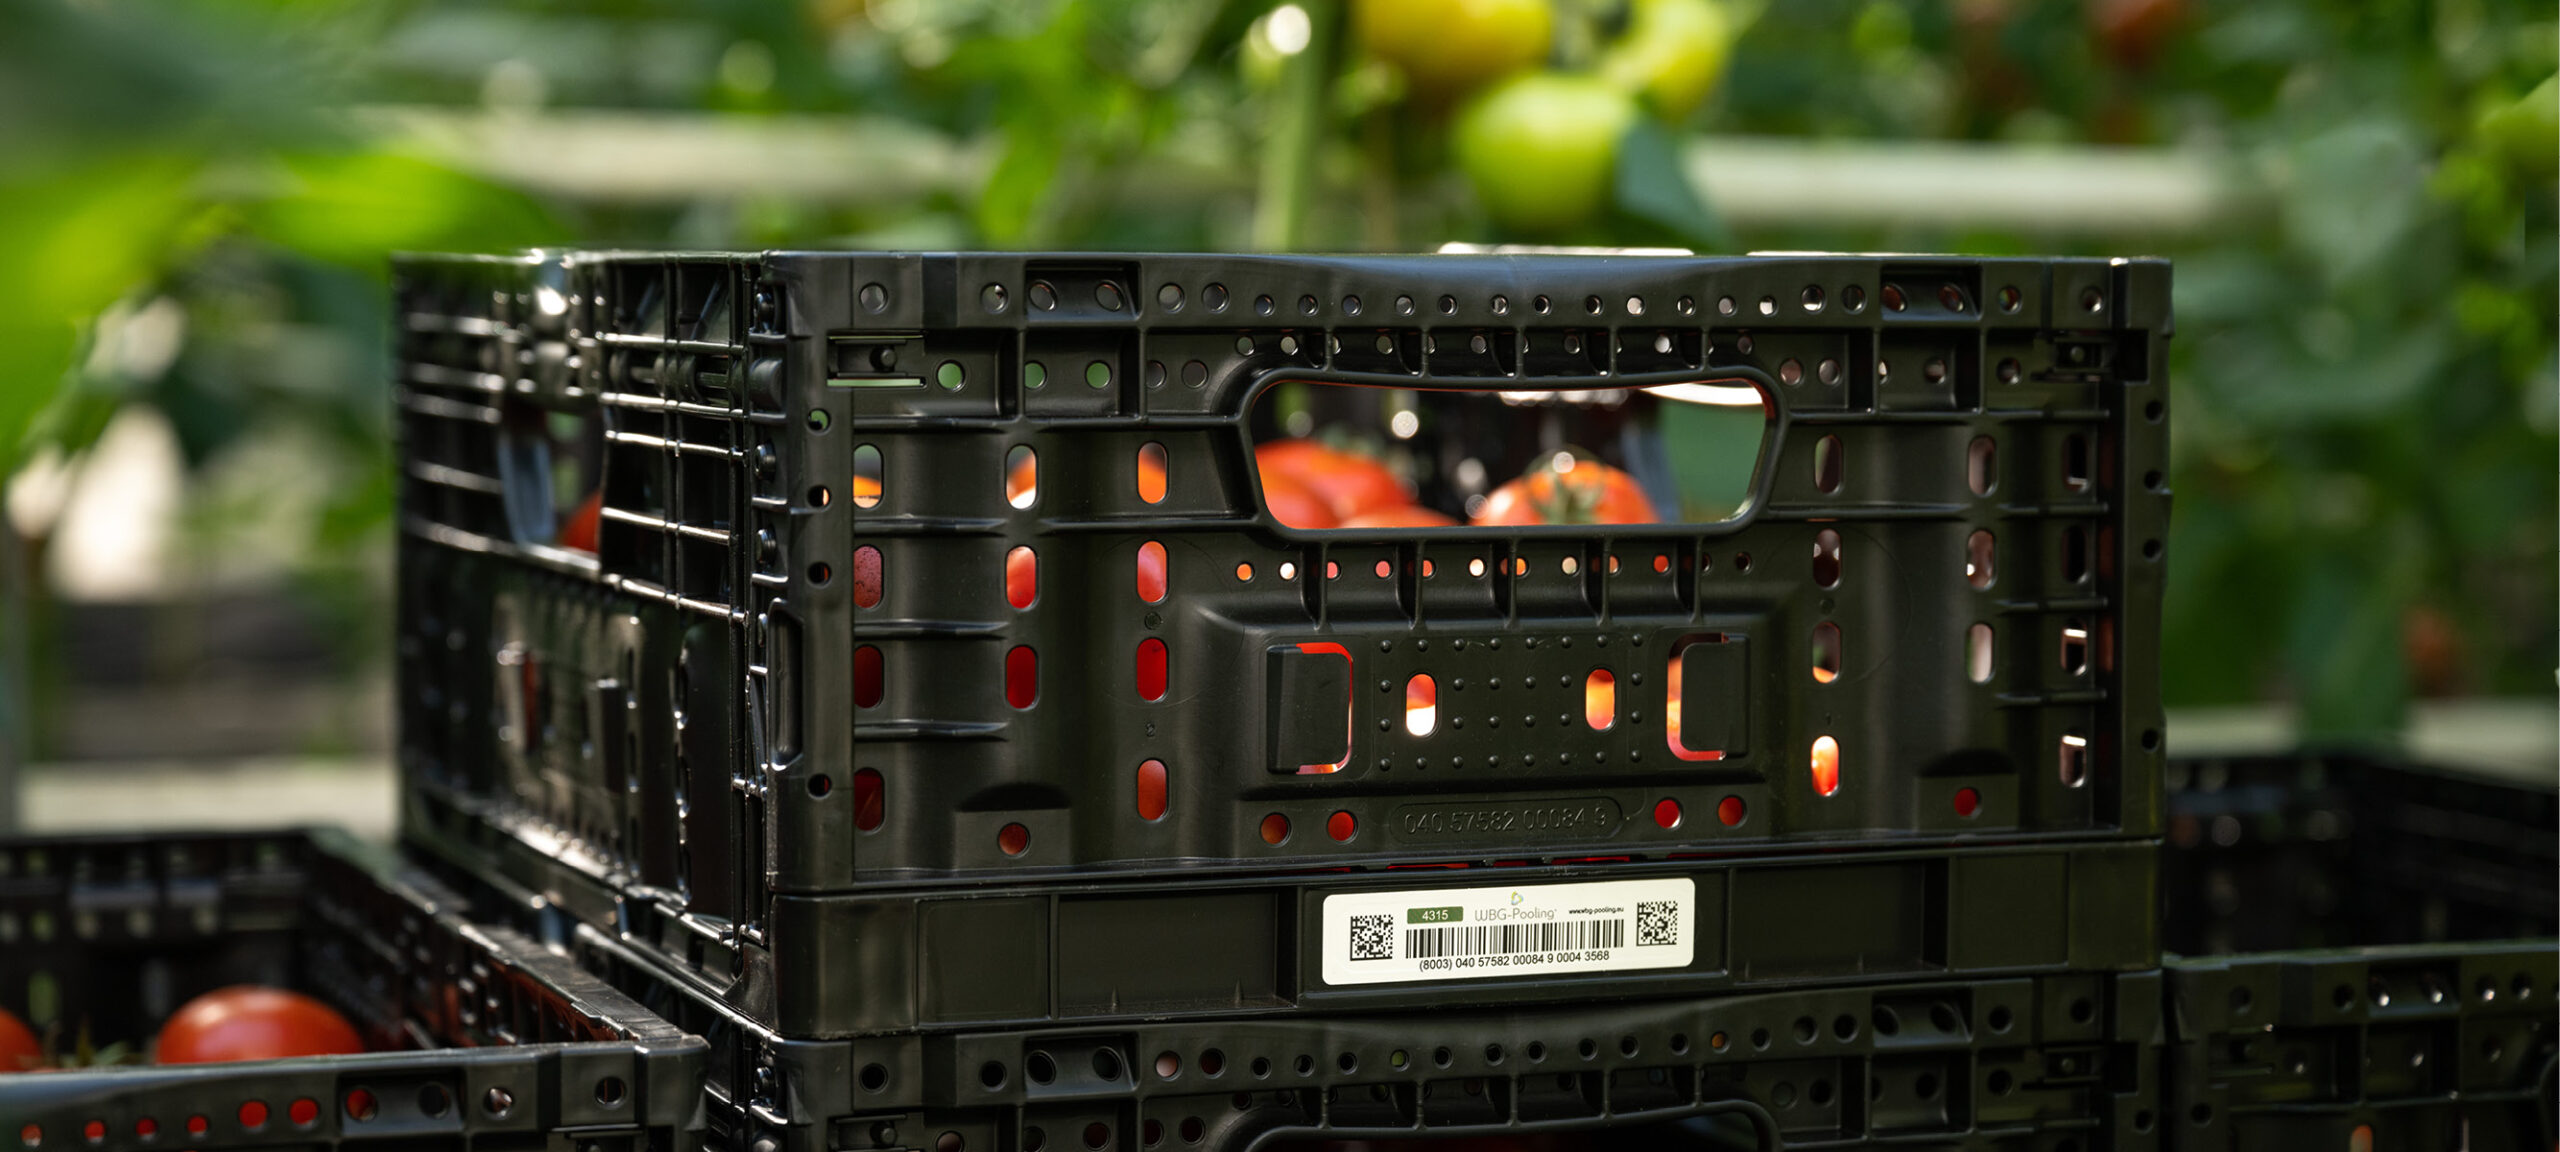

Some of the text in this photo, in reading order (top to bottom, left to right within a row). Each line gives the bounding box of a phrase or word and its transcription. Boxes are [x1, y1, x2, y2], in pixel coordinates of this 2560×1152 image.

[1404, 811, 1443, 834] 040
[1449, 809, 1515, 833] 57582
[1522, 806, 1585, 830] 00084
[1422, 910, 1449, 921] 4315
[1475, 908, 1555, 921] WBG-Pooling
[1419, 950, 1610, 972] (8003) 040 57582 00084 9 0004 3568
